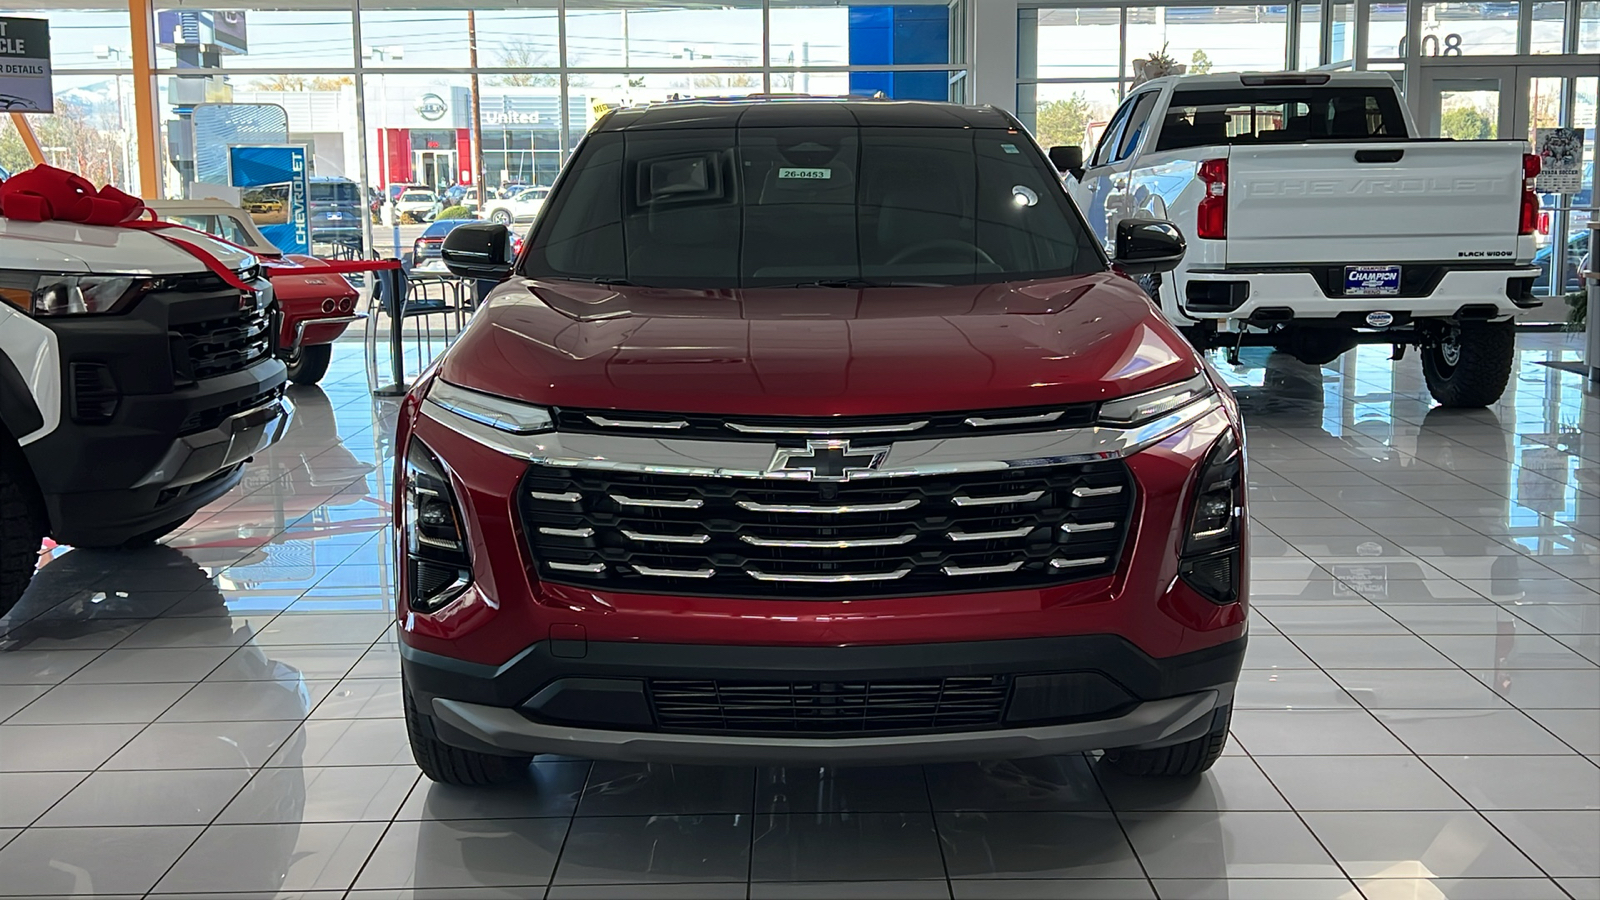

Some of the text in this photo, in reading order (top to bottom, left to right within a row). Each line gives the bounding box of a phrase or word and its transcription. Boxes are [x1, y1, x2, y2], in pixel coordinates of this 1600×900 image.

[5, 64, 44, 75] DETAILS
[486, 110, 540, 124] United
[292, 151, 307, 245] CHEVROLET
[1349, 271, 1397, 280] CHAMPION
